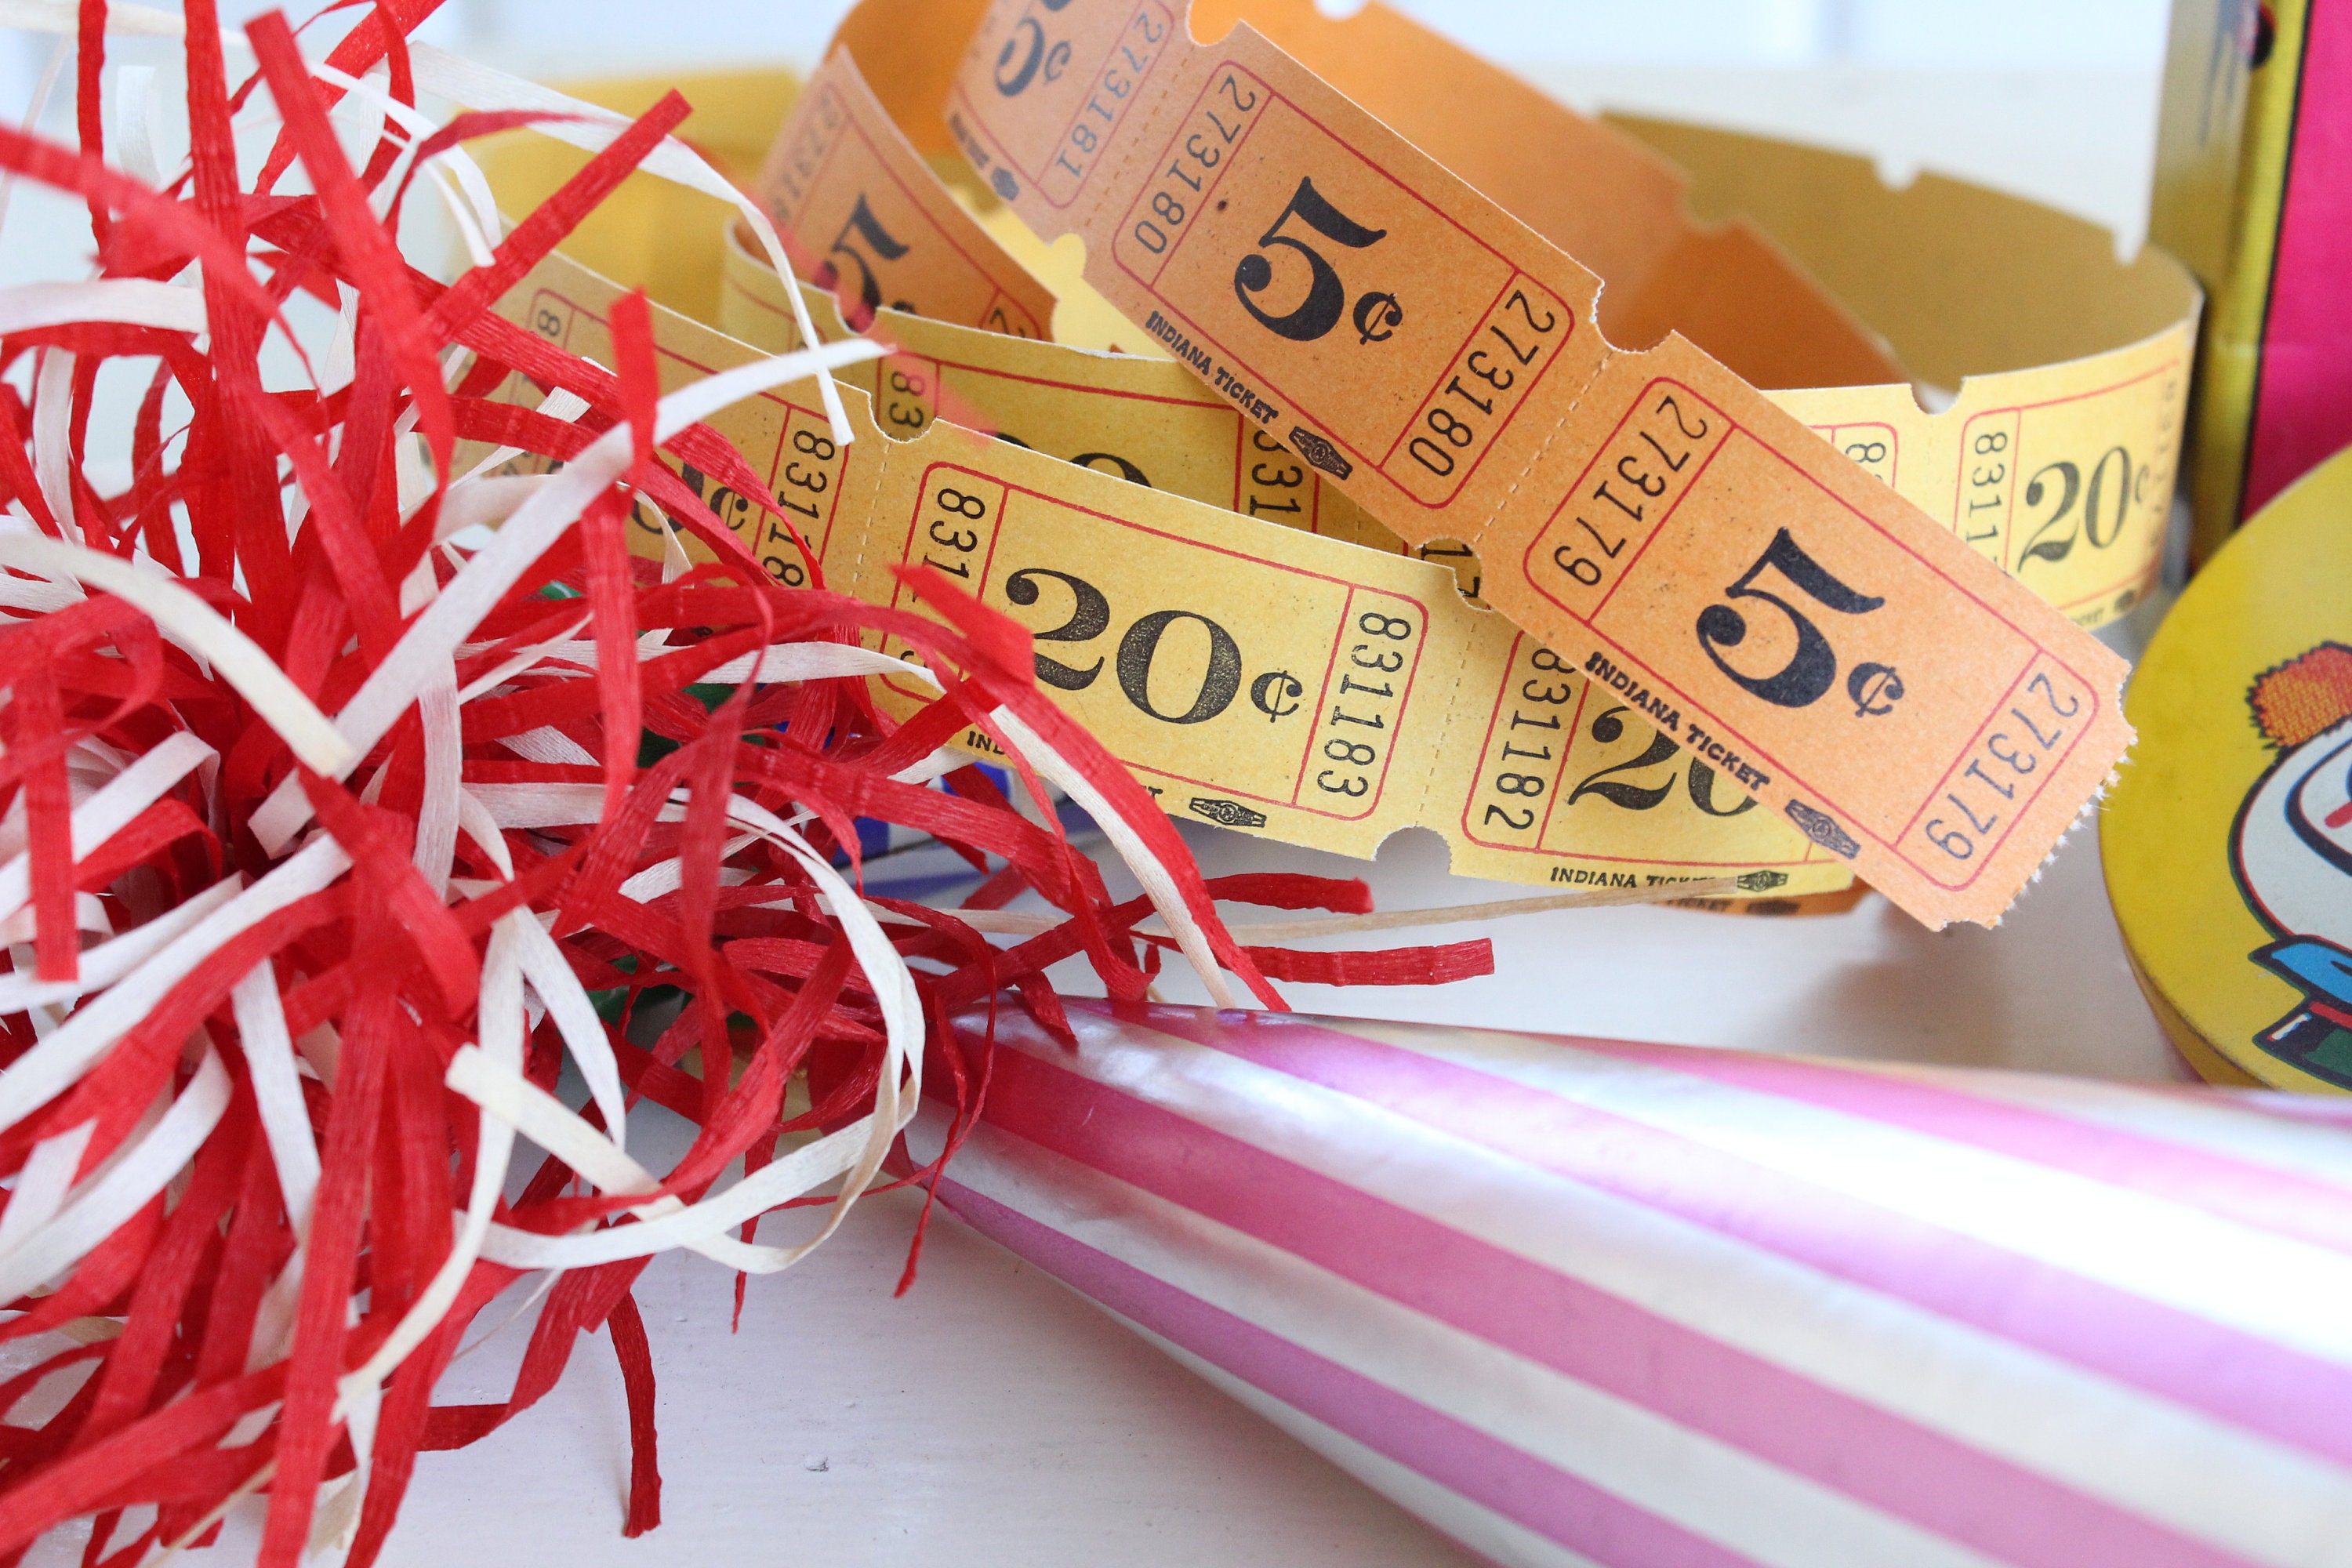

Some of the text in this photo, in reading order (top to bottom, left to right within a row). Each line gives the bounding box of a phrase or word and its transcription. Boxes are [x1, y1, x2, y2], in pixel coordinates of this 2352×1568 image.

[1056, 12, 1163, 179] 273181
[1134, 74, 1256, 255] 273180
[1234, 176, 1403, 345] 5¢
[1145, 310, 1279, 425] INDIANA TICKET
[1408, 289, 1556, 477] 273180
[761, 429, 837, 588] 83118
[1552, 394, 1709, 587] 273179
[1965, 431, 2009, 569] 8311
[1005, 568, 1305, 725] 20¢
[1317, 610, 1413, 798] 831183
[1695, 525, 1905, 719] 5¢
[1484, 647, 1574, 833] 831182
[1585, 652, 1771, 792] INDIANA TICKET
[1926, 673, 2079, 862] 273179
[1550, 866, 1637, 888] INDIANA
